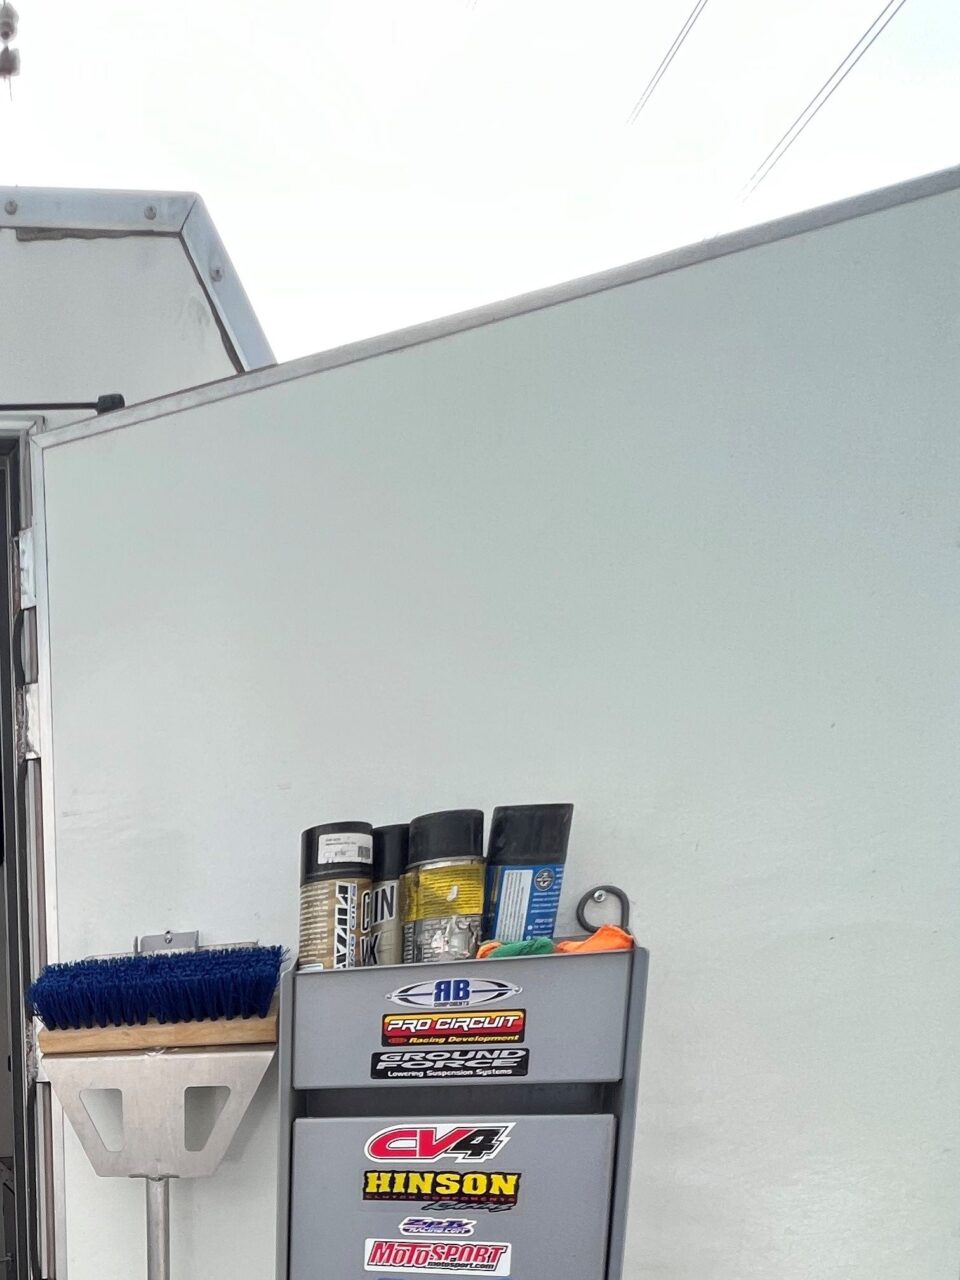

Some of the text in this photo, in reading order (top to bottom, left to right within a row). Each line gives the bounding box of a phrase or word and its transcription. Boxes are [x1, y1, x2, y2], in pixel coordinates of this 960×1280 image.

[387, 1016, 521, 1033] PRO CIRCUIT
[409, 1036, 446, 1044] Racing
[448, 1034, 520, 1043] Development
[379, 1050, 527, 1062] GROUND
[376, 1058, 522, 1070] FORCE
[388, 1068, 513, 1078] Lowering Suspension Systems
[368, 1126, 506, 1159] CV4
[365, 1172, 517, 1195] HINSON
[427, 1261, 495, 1269] motosport.com
